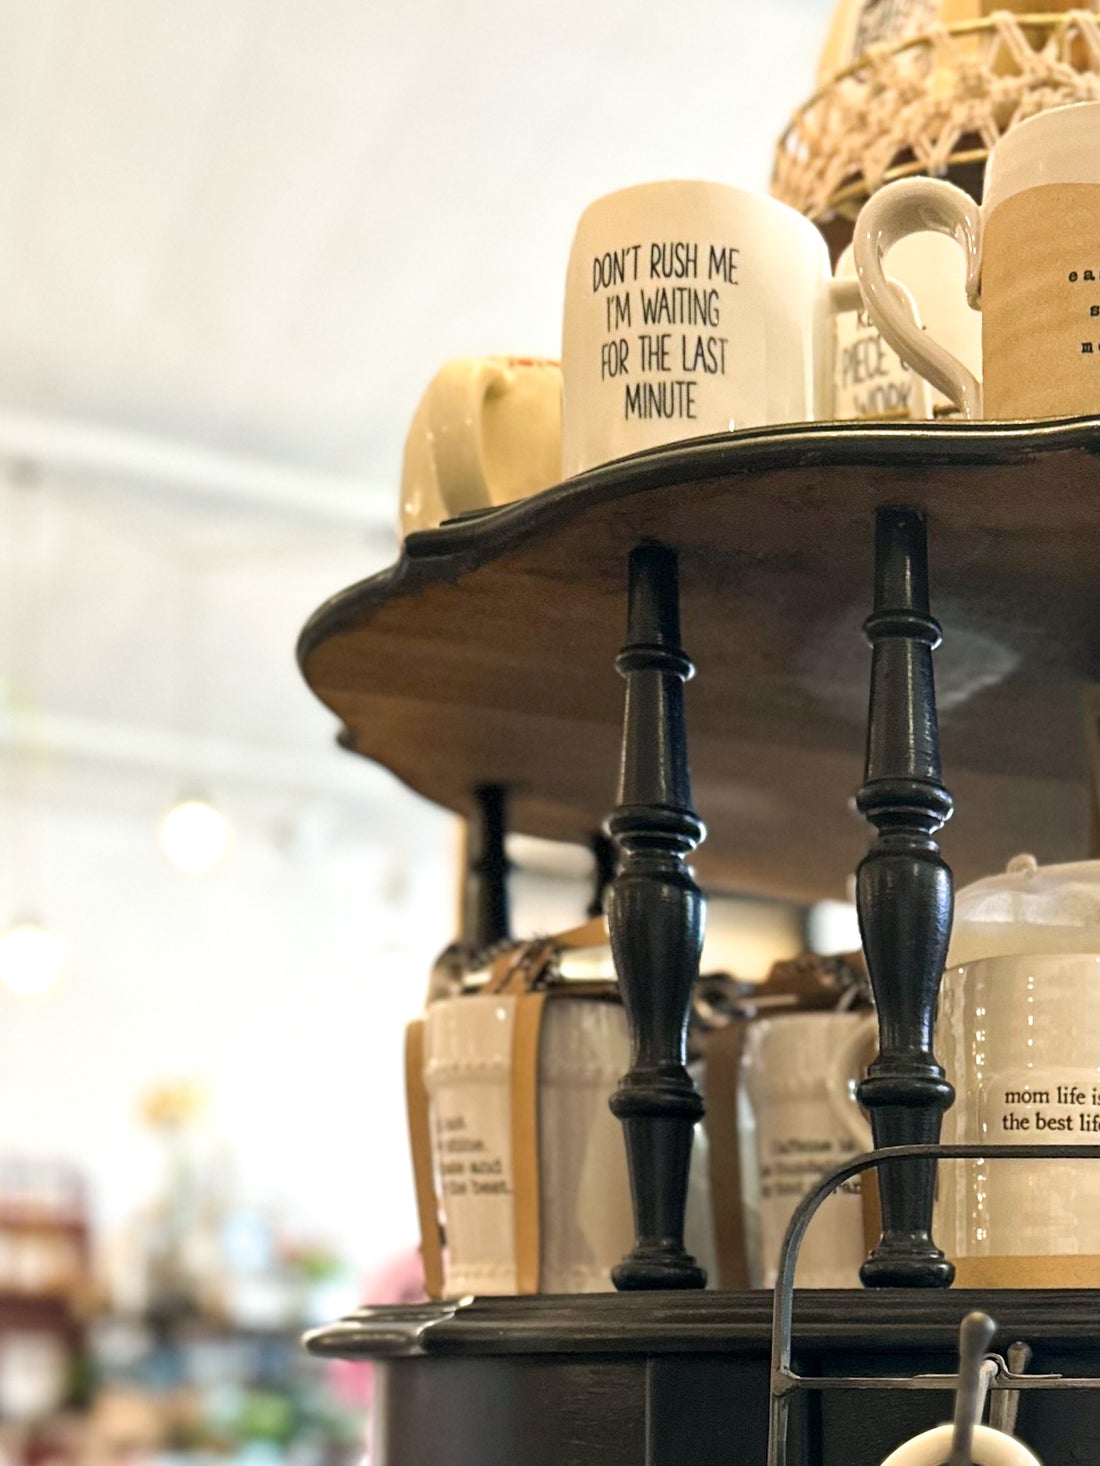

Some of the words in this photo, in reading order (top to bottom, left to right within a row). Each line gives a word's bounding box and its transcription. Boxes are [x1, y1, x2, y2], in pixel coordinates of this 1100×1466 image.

[593, 244, 642, 293] DON'T
[649, 242, 698, 279] RUSH
[708, 245, 740, 285] ME
[606, 292, 632, 333] I'M
[640, 287, 719, 327] WAITING
[601, 338, 630, 380] FOR
[638, 334, 672, 373] THE
[682, 336, 728, 376] LAST
[625, 381, 698, 421] MINUTE
[1004, 1090, 1050, 1105] mom
[1057, 1086, 1086, 1105] life
[1002, 1114, 1030, 1131] the
[1035, 1112, 1073, 1131] best
